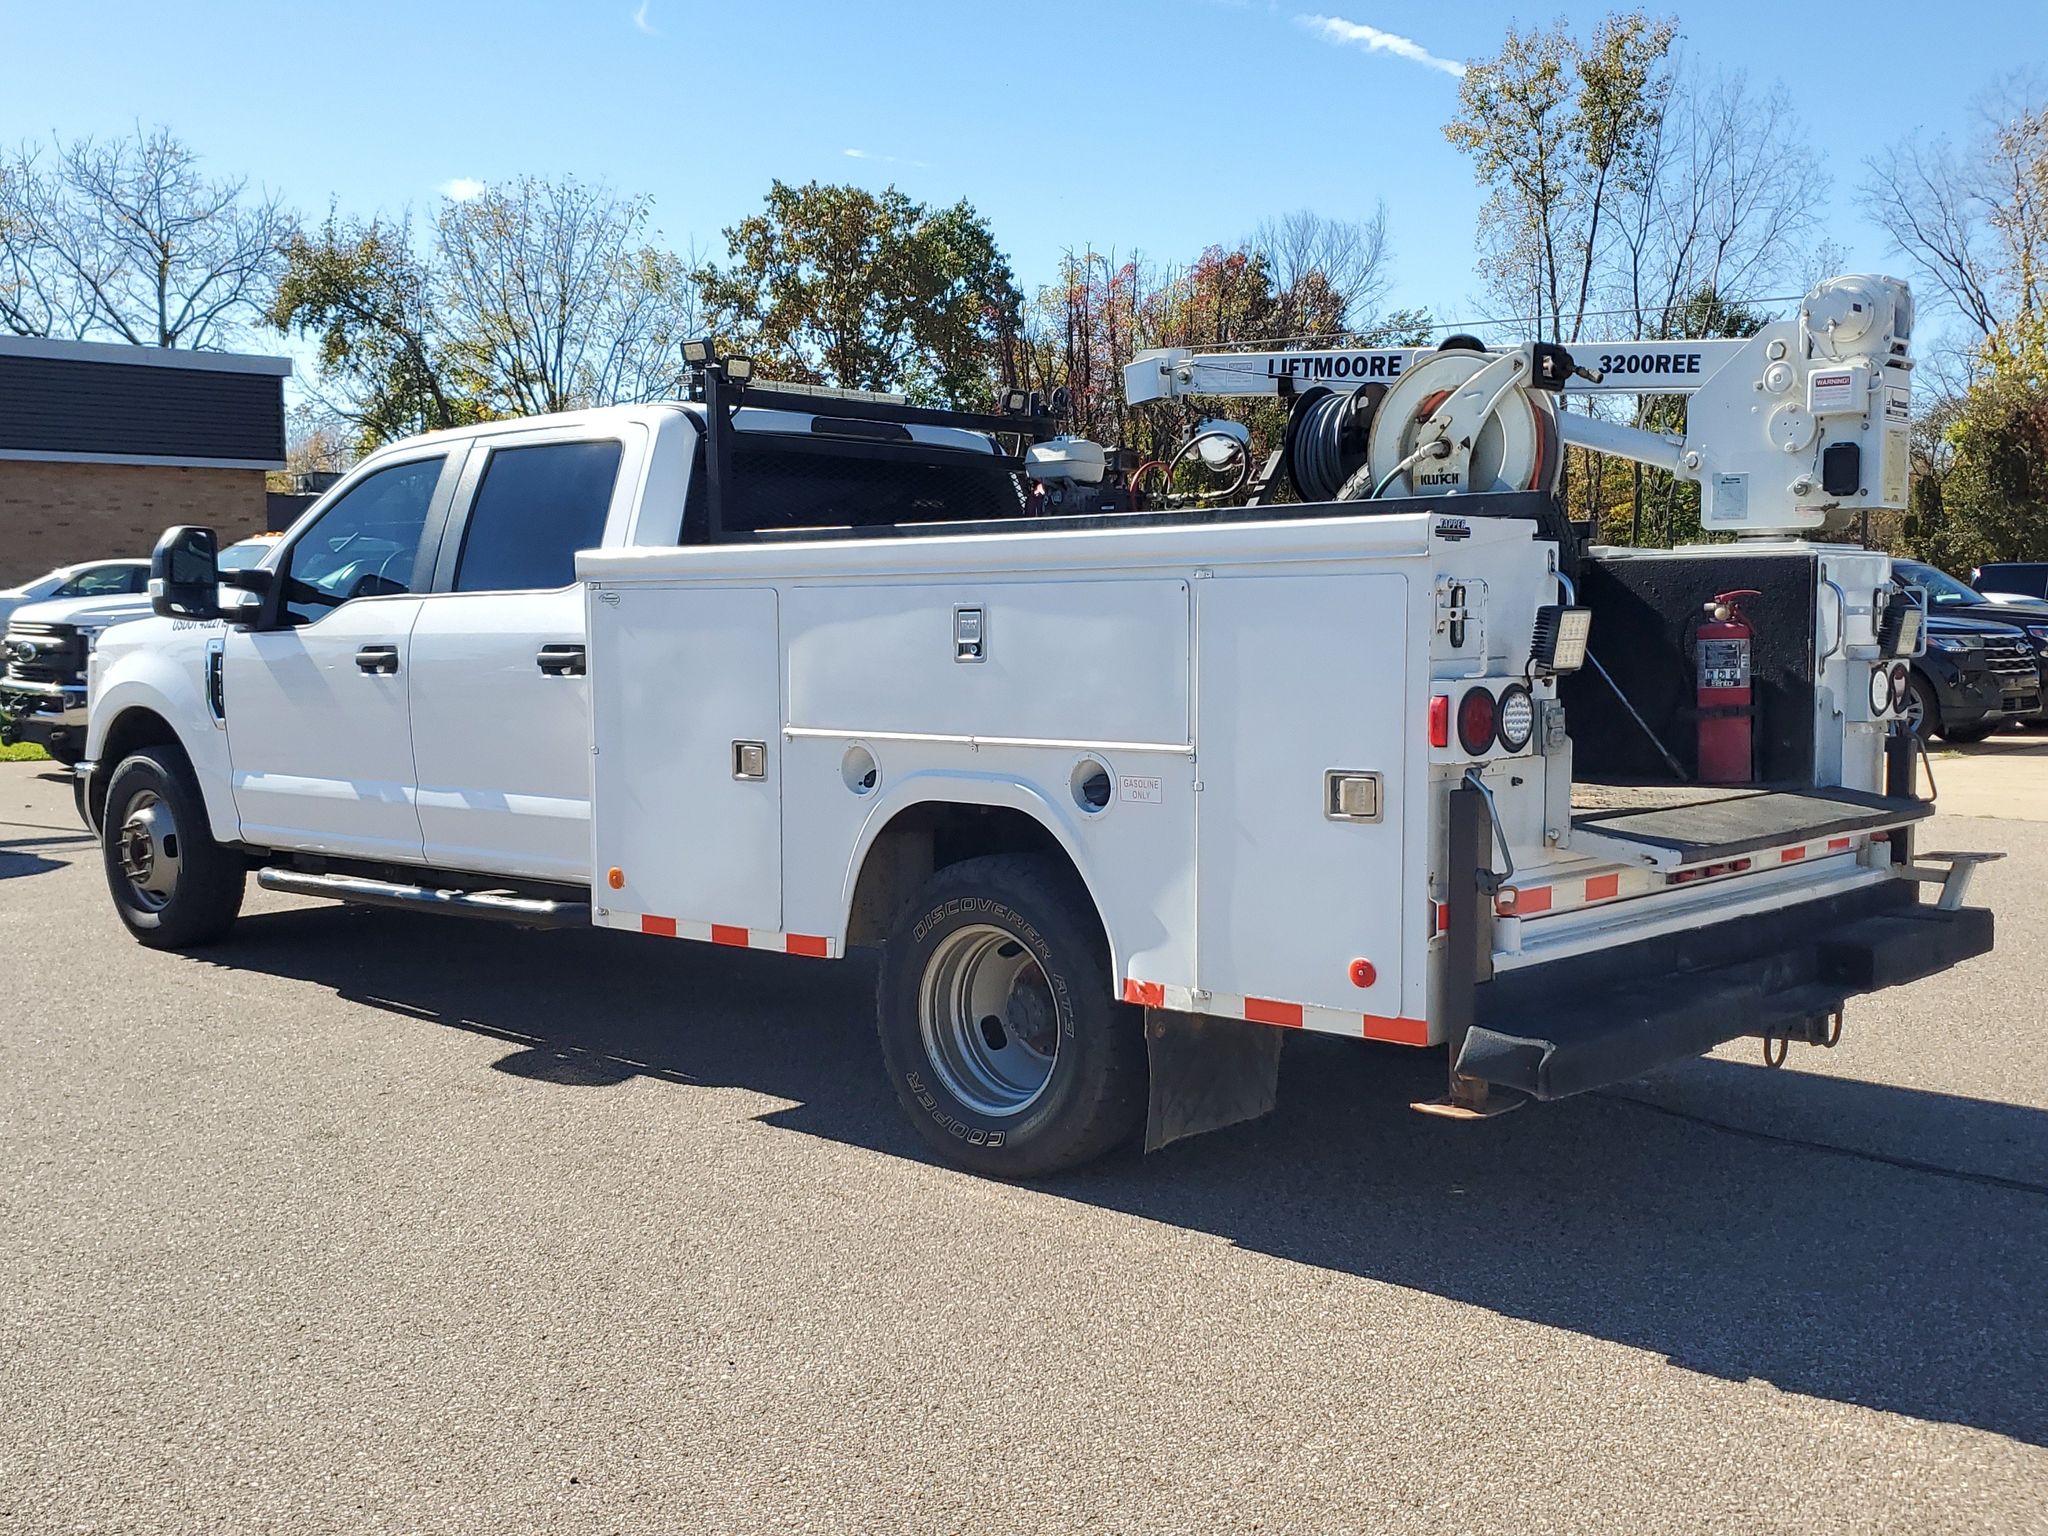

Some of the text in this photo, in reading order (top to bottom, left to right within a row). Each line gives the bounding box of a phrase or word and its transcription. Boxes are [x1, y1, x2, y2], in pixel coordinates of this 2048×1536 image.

[1268, 356, 1402, 379] LIFTMOORE
[1598, 354, 1702, 374] 3200REE
[1816, 377, 1850, 386] WARNING!
[1420, 472, 1459, 486] KLUTCH
[1123, 778, 1159, 790] GASOLINE
[1132, 790, 1151, 800] ONLY
[912, 897, 1052, 959] DISCOVERER
[906, 1071, 1006, 1148] COOPER
